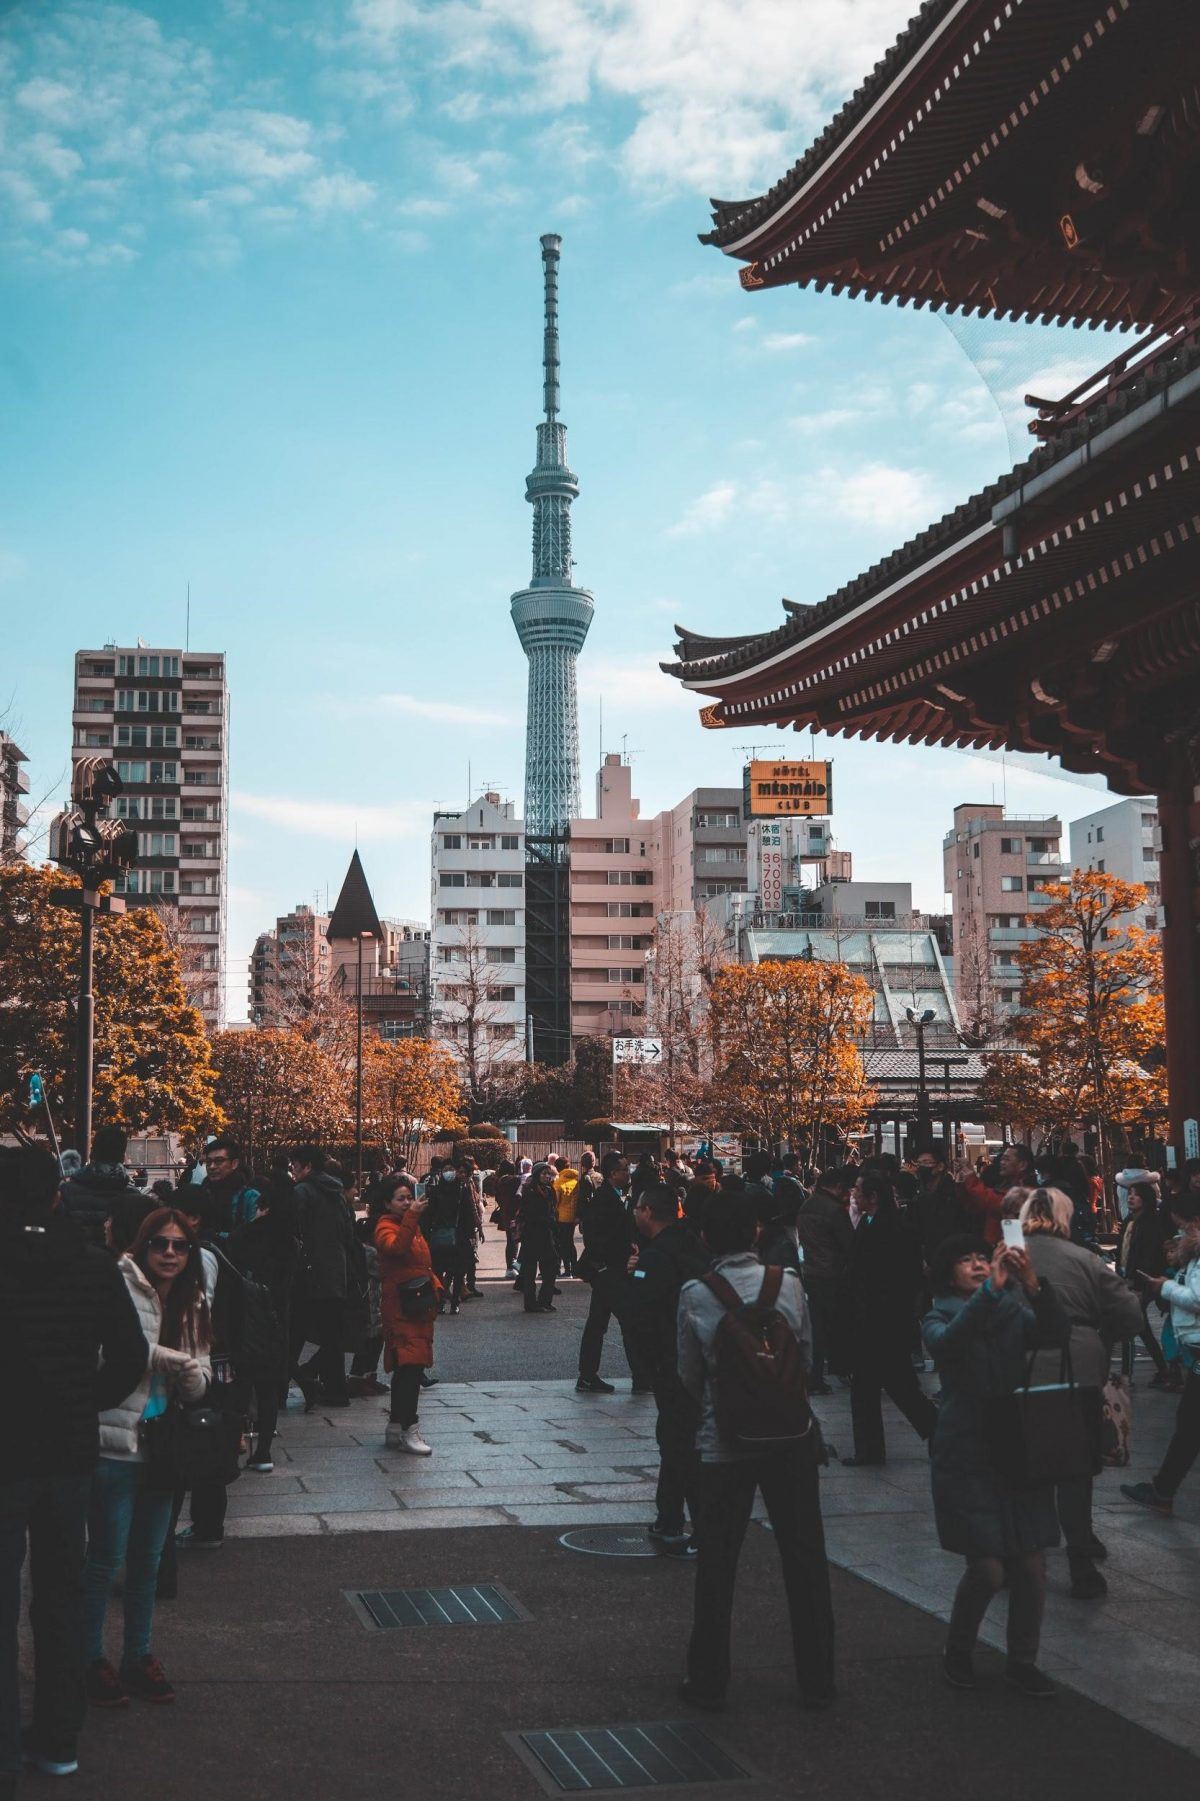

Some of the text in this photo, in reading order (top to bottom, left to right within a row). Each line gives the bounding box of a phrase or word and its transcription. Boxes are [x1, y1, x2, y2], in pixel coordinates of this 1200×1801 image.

[778, 800, 810, 809] CLUB
[762, 824, 771, 846] 休憩
[771, 824, 781, 846] 宿泊
